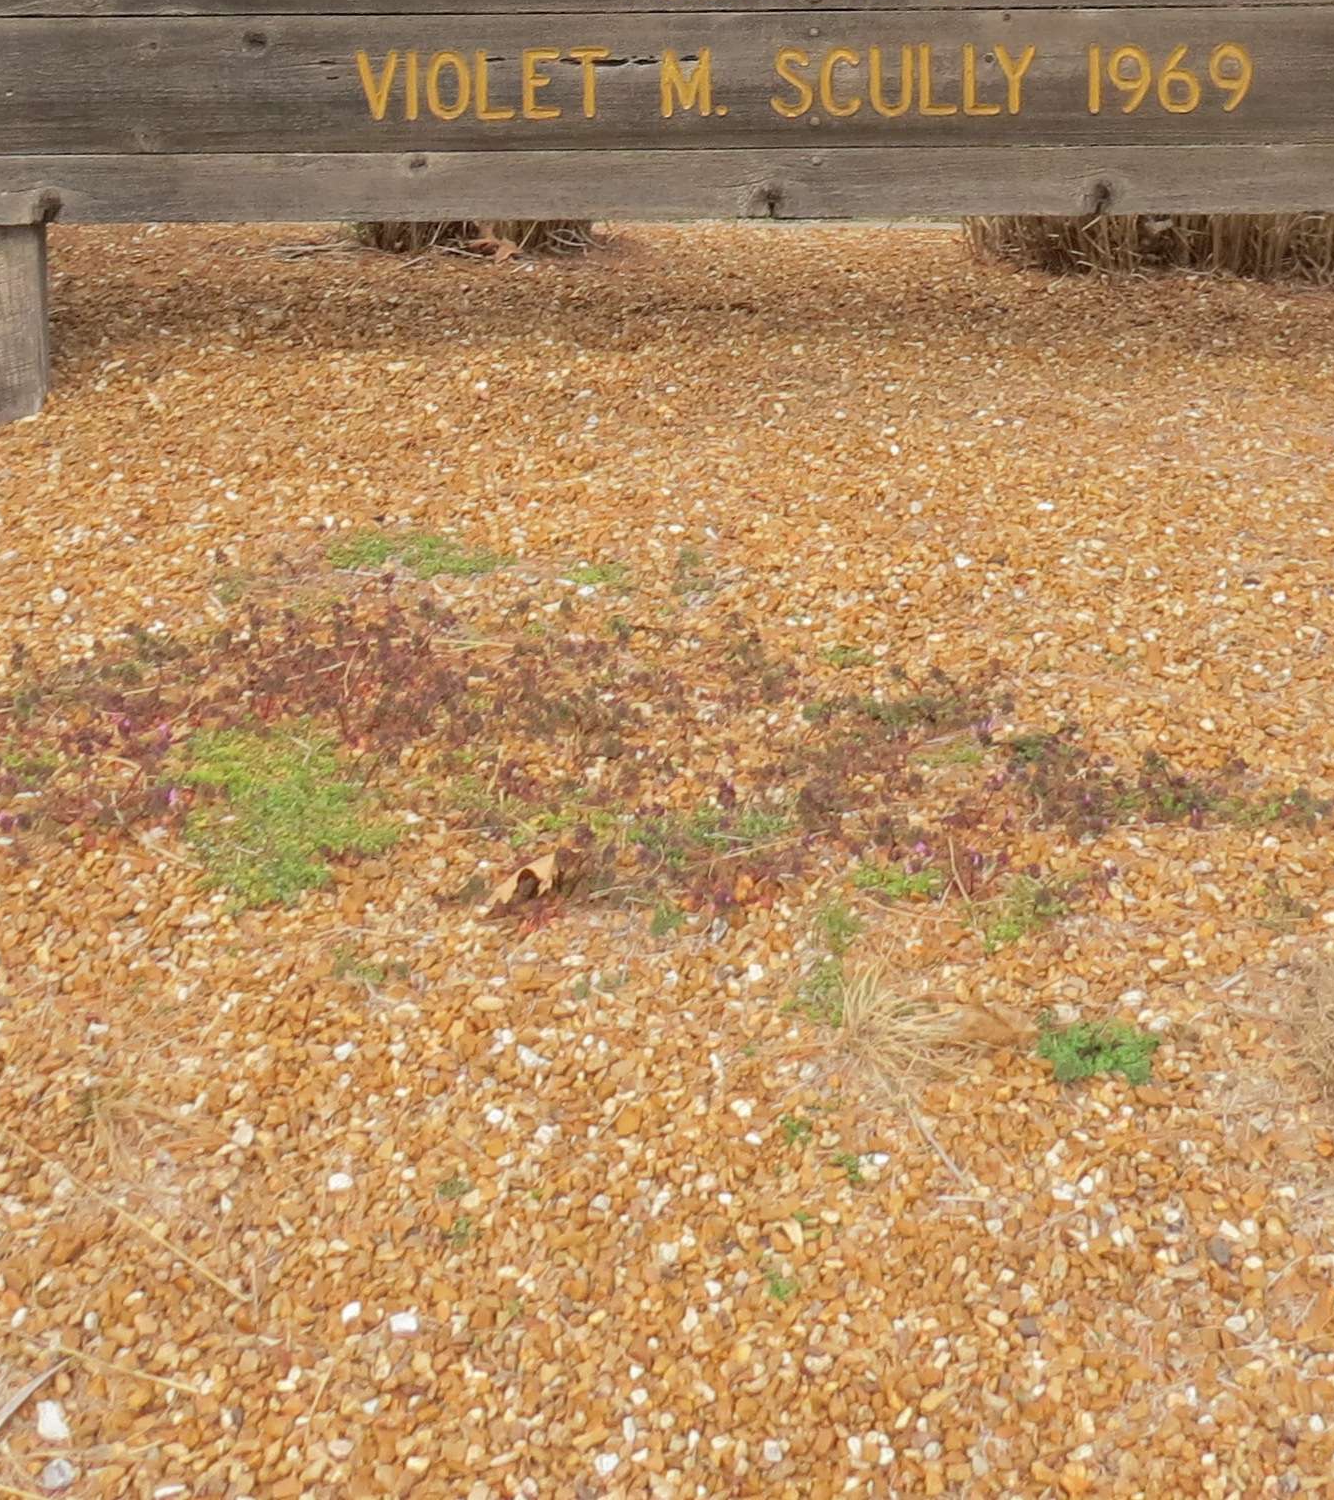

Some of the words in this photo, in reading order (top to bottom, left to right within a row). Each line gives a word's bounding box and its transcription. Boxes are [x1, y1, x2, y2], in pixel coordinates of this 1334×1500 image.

[352, 44, 612, 123] VIOLET
[658, 45, 730, 118] M.
[768, 41, 1037, 122] SCULLY
[1084, 39, 1255, 116] 1969
